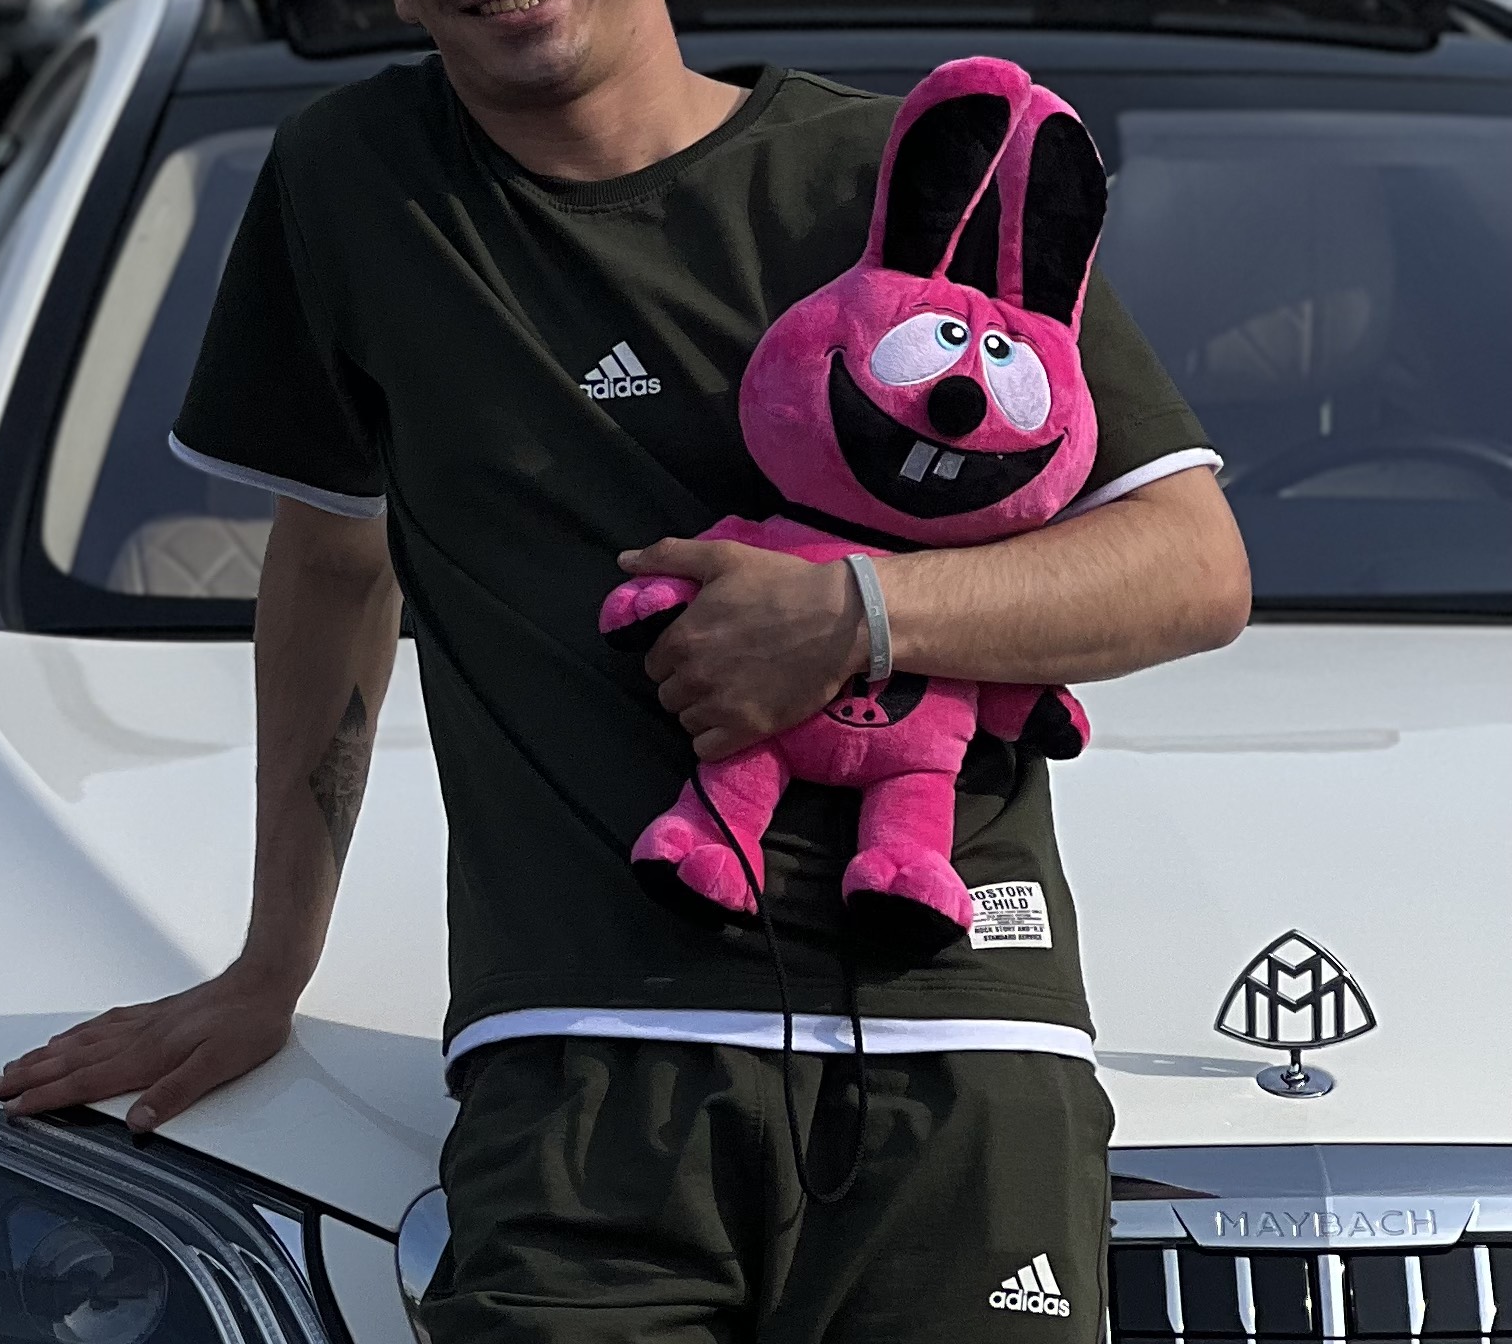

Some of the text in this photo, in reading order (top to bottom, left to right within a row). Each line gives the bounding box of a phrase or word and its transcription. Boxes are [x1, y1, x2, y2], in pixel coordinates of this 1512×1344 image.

[982, 898, 1029, 910] CHILD
[1215, 1209, 1438, 1238] MAYBACH
[989, 1288, 1071, 1318] adidas
